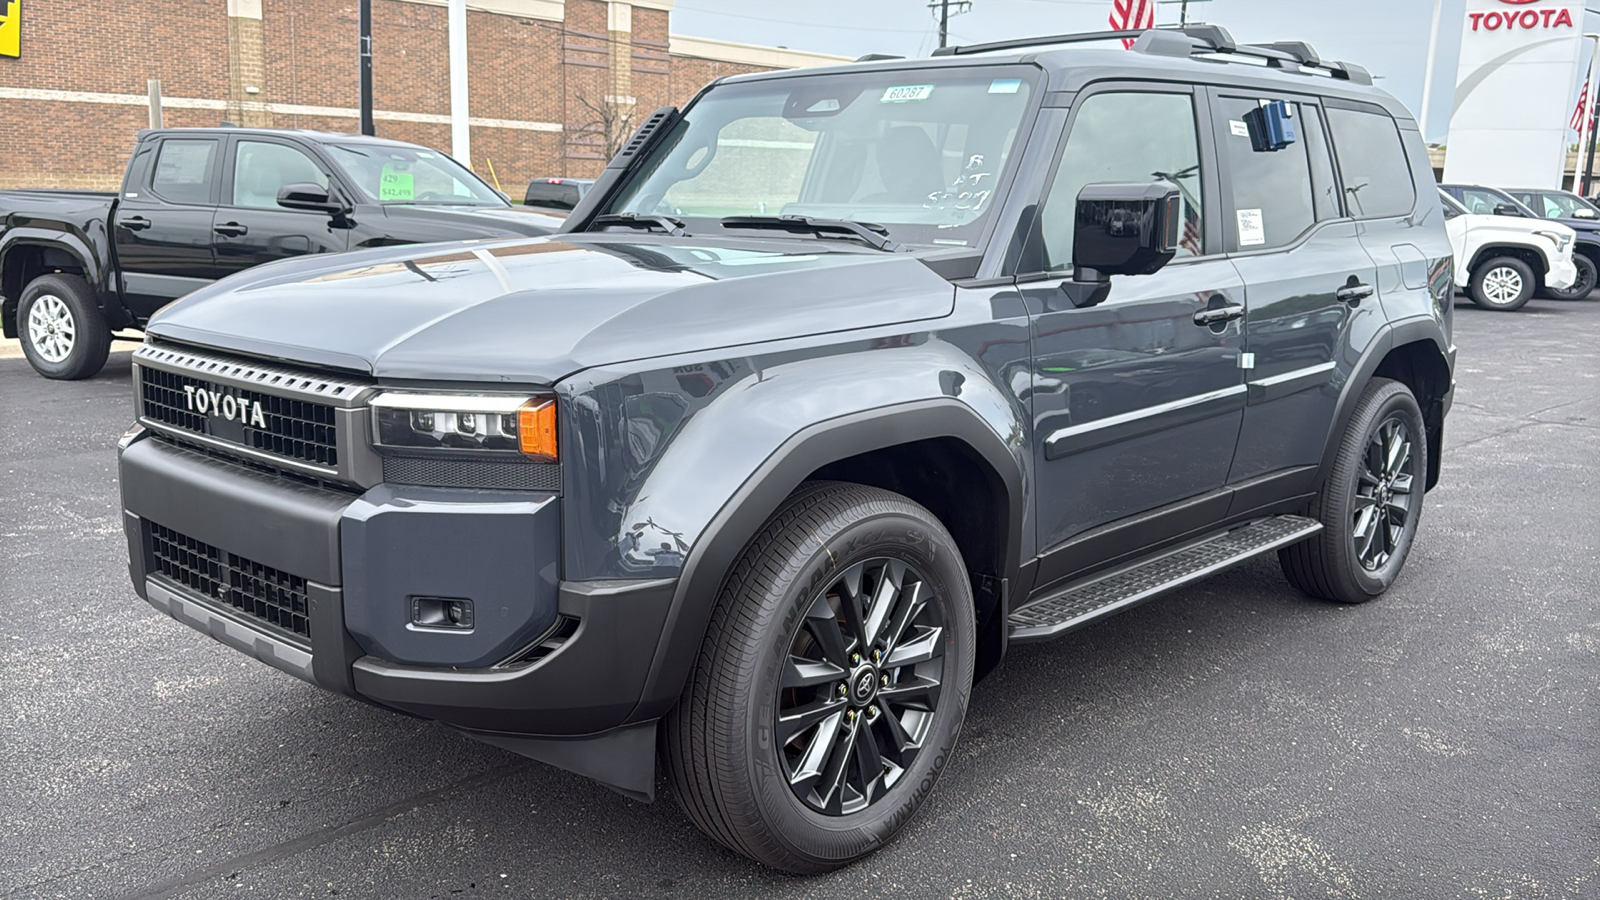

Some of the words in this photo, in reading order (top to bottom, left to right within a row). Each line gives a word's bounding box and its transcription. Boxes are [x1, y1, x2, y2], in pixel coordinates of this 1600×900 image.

[1469, 9, 1572, 31] TOYOTA
[889, 87, 925, 99] 60287
[382, 175, 398, 183] 429
[382, 188, 412, 197] $42,498
[184, 385, 266, 428] TOYOTA
[883, 746, 950, 834] YOKOHAMA
